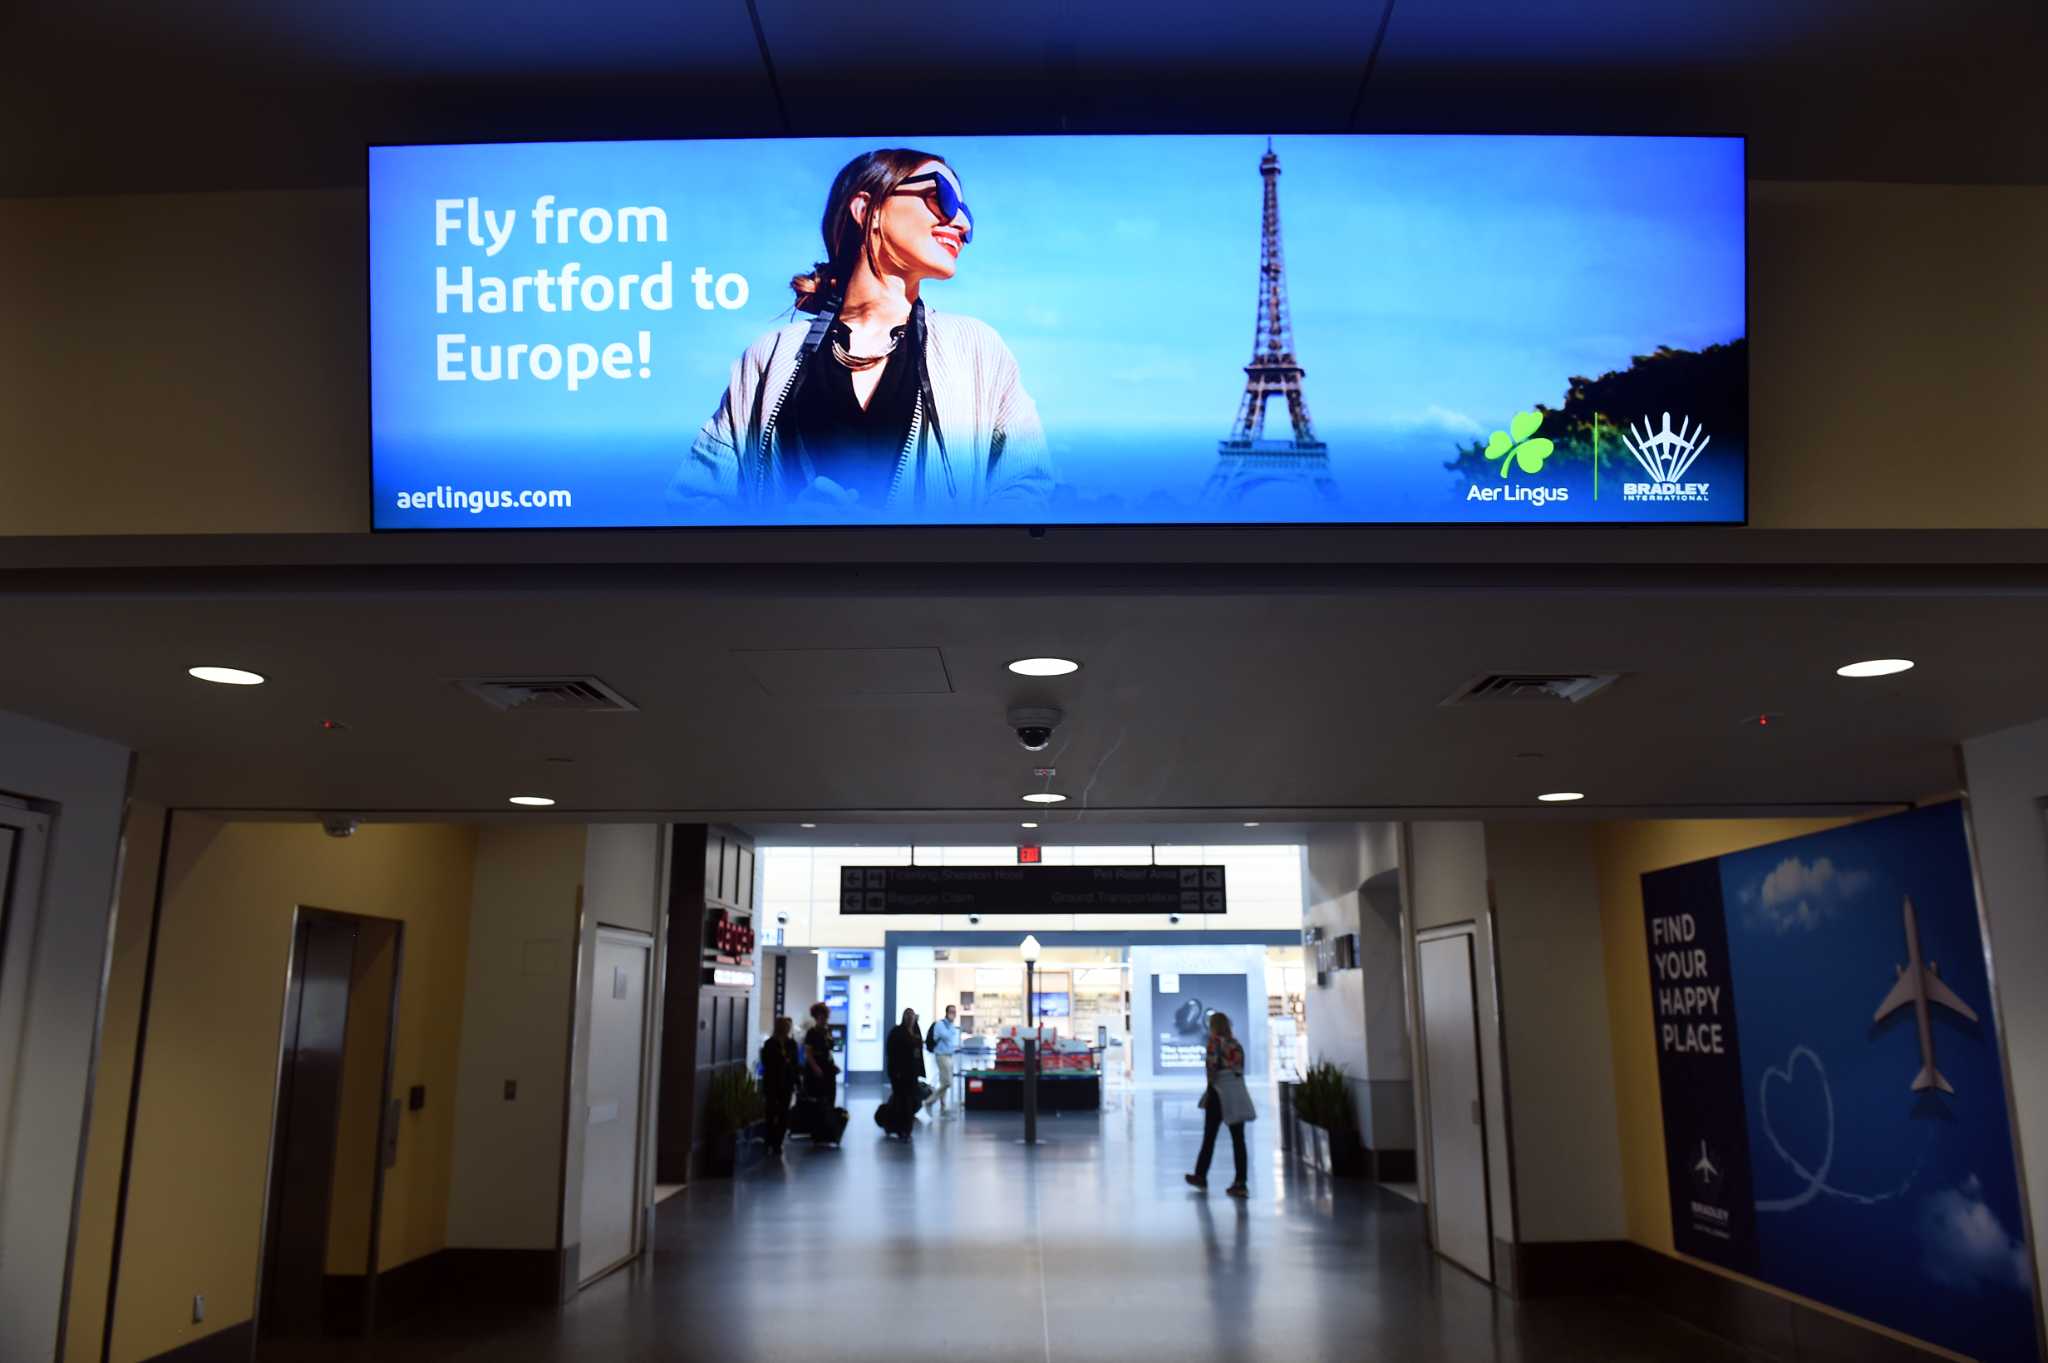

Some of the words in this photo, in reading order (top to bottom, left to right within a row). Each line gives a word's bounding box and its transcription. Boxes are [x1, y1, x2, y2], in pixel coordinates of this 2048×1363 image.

[435, 197, 516, 257] Fly
[531, 195, 668, 244] from
[436, 261, 673, 314] Hartford
[690, 266, 750, 311] to
[436, 330, 652, 392] Europe!
[396, 486, 572, 514] aerlingus.com
[1466, 484, 1502, 501] Aer
[1504, 484, 1569, 507] Lingus
[1623, 483, 1710, 495] BRADLEY
[1623, 494, 1710, 502] INTERNATIONAL
[1652, 913, 1696, 945] FIND
[1655, 948, 1708, 980] YOUR
[1659, 986, 1720, 1015] HAPPY
[1662, 1023, 1724, 1054] PLACE
